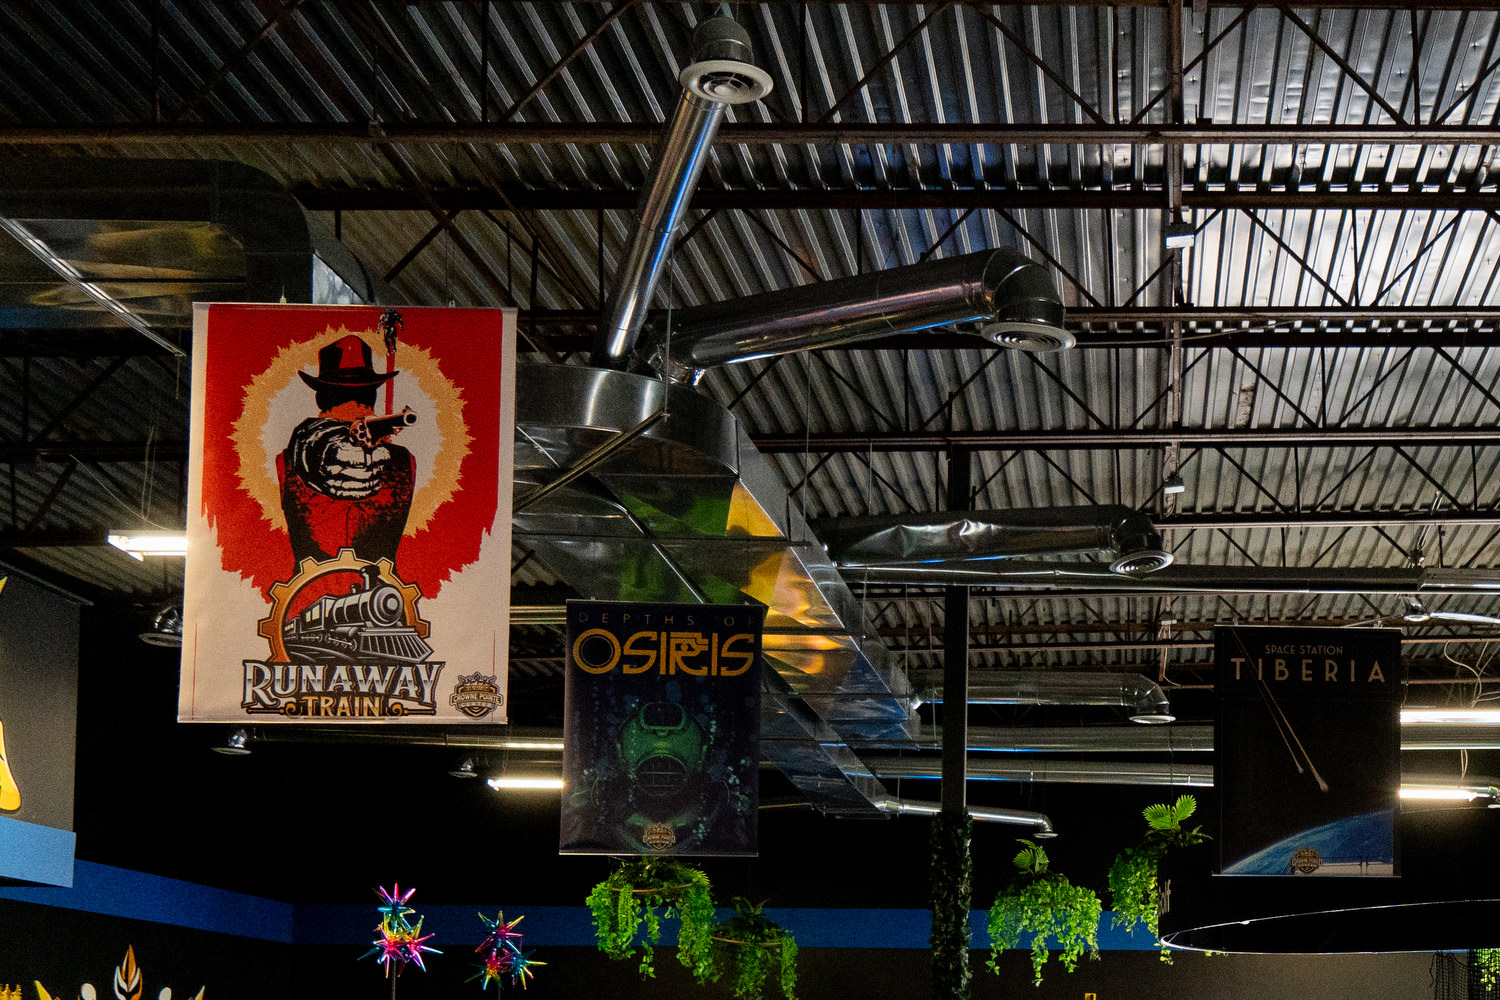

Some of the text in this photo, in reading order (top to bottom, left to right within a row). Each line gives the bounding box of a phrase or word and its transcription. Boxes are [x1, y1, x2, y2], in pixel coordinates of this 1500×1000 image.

[578, 612, 696, 627] DEPTHS
[573, 628, 755, 676] OSIRIS
[1265, 644, 1344, 655] SPACE STATION
[1230, 657, 1385, 683] TIBERIA
[241, 660, 446, 709] RUNAWAY
[301, 696, 382, 717] TRAIN
